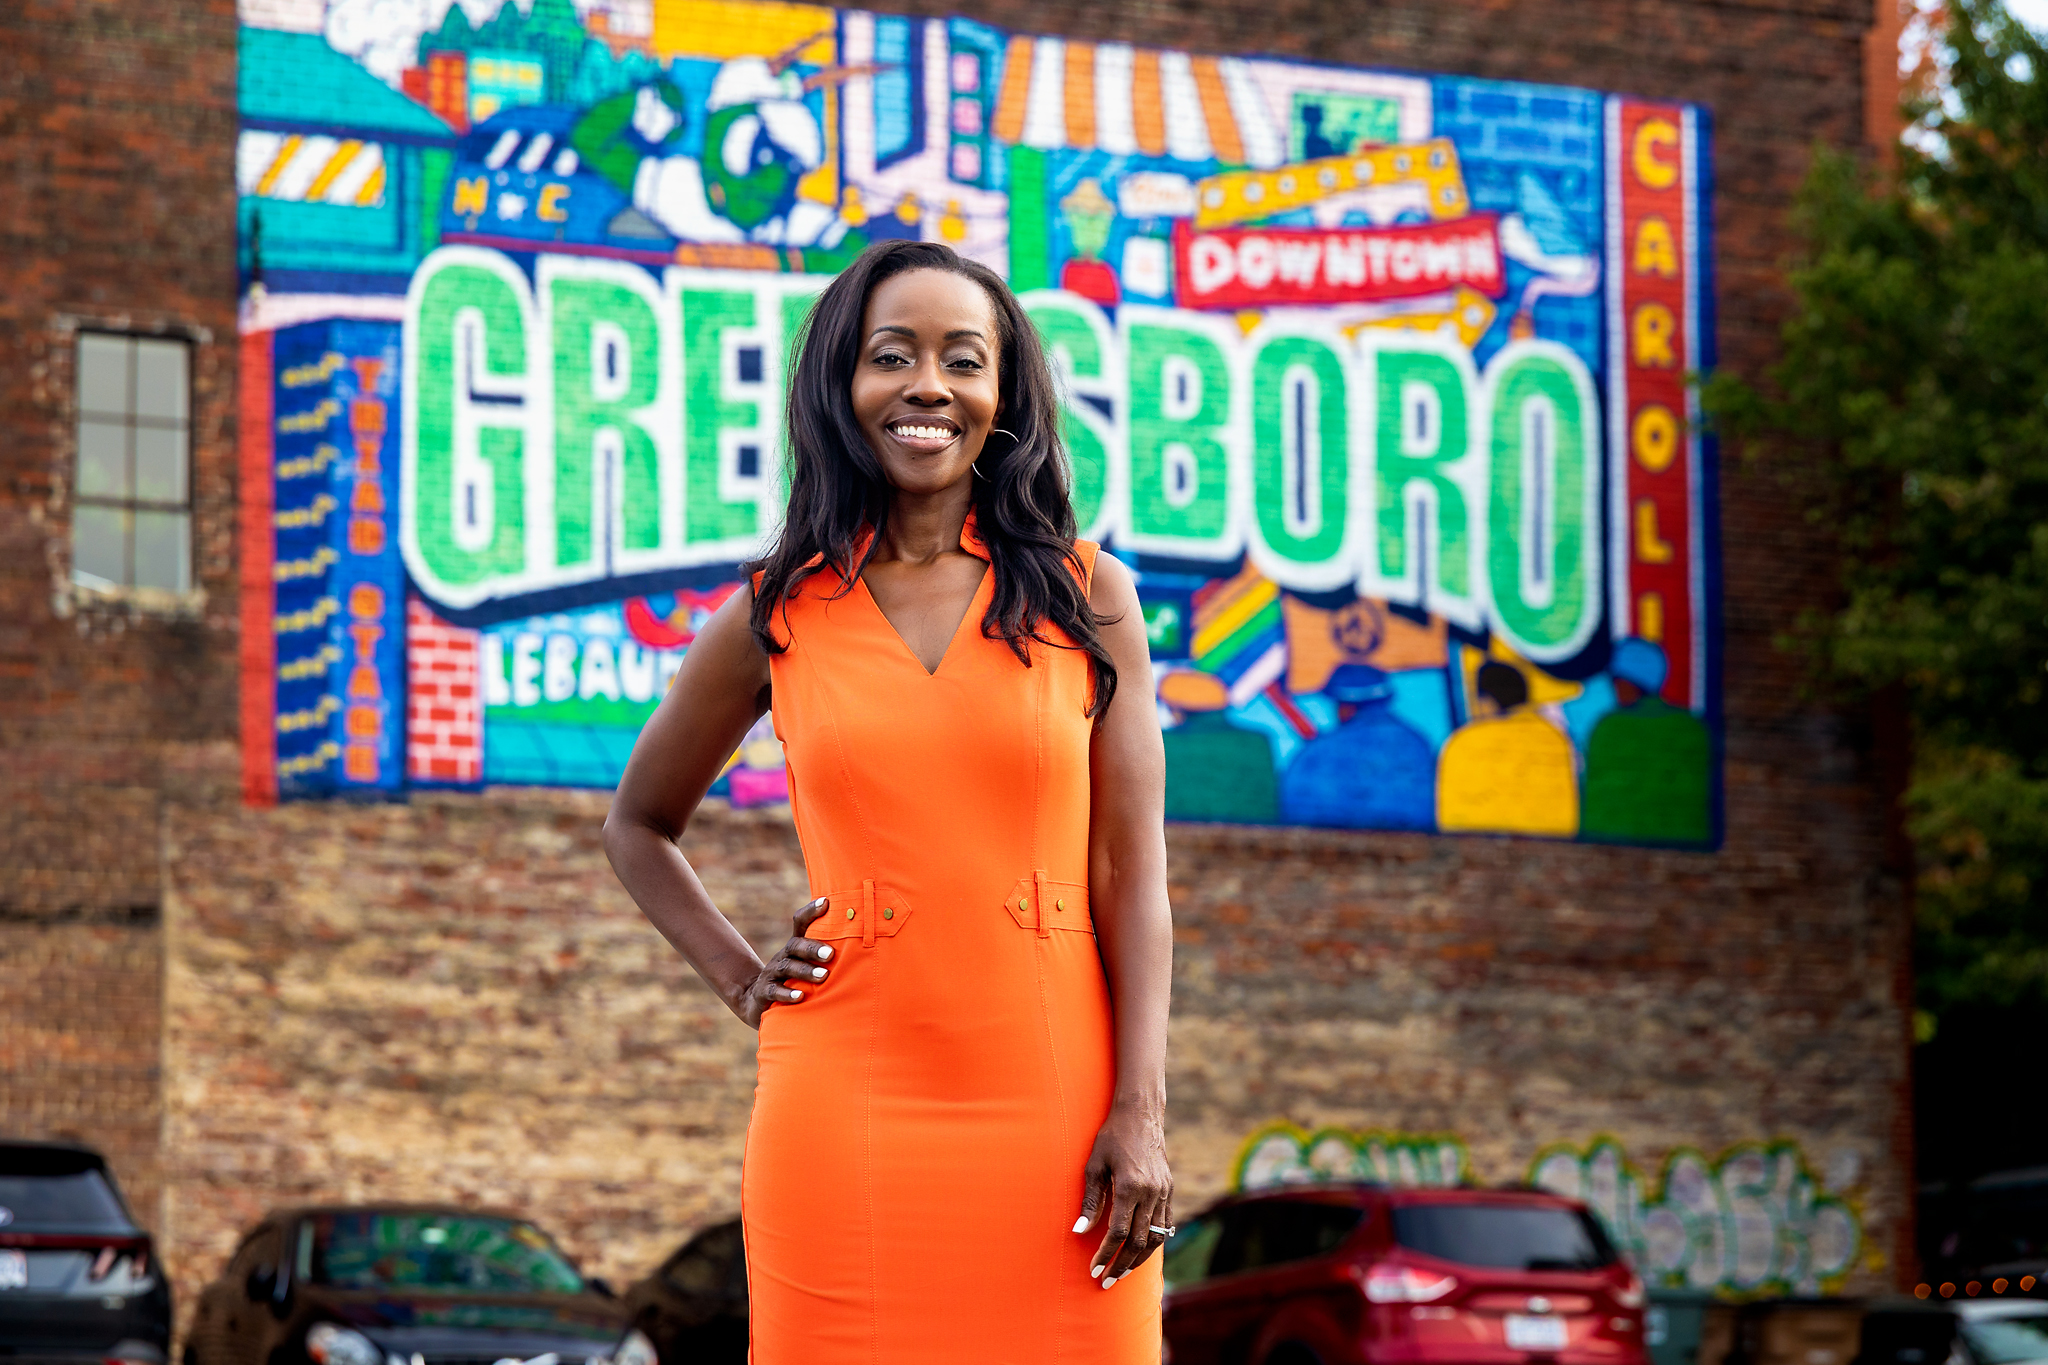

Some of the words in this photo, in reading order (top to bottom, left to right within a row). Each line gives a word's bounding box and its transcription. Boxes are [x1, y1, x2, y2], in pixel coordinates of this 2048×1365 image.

[535, 182, 572, 223] C
[1189, 229, 1498, 295] DOWNTOWN
[401, 246, 1600, 662] GRESBORO
[1630, 116, 1680, 643] CAROLI
